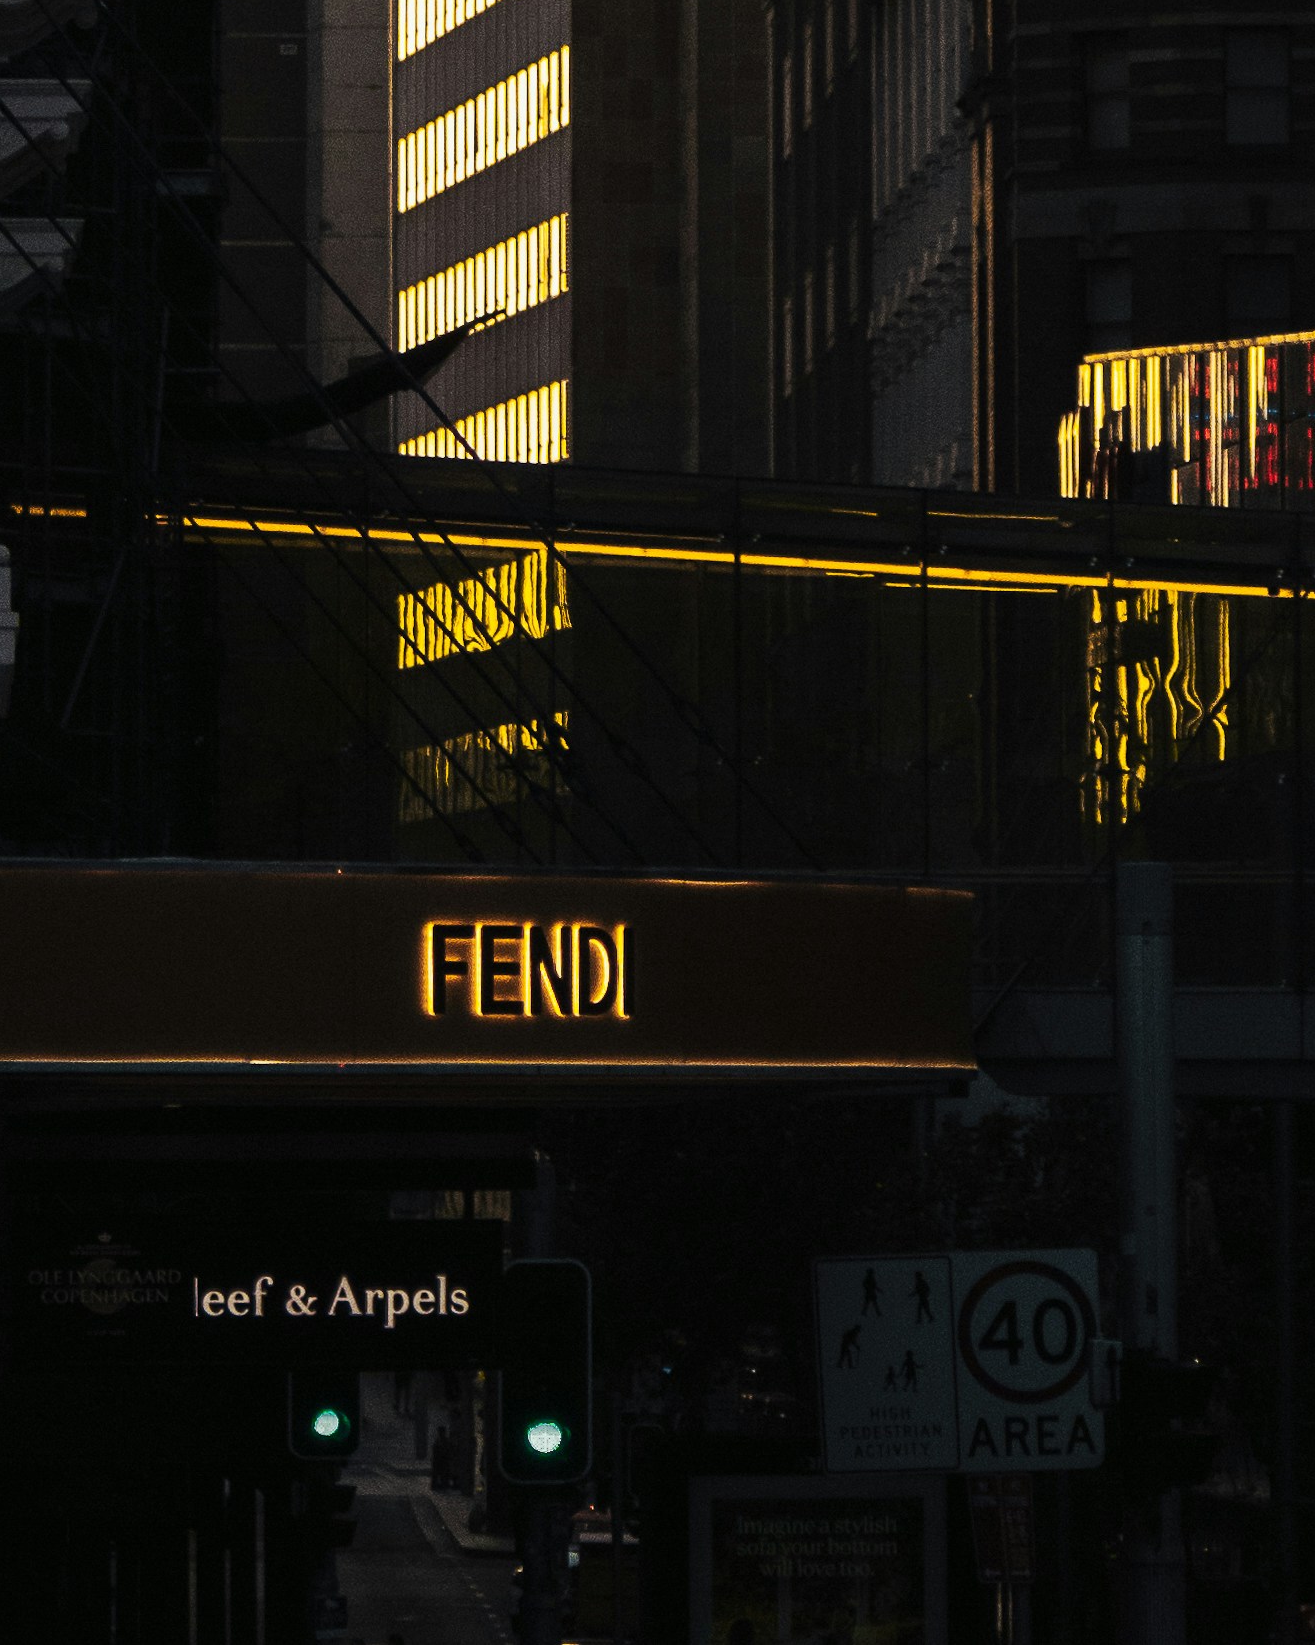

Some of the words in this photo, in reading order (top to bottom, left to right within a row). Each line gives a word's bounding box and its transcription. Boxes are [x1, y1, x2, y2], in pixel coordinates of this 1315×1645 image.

[424, 921, 635, 1018] FENDI
[27, 1270, 64, 1285] OLE
[68, 1269, 182, 1285] LYNGGAARD
[40, 1288, 169, 1304] COPENHAGEN
[285, 1284, 318, 1316] &
[328, 1274, 471, 1329] Arpels
[978, 1298, 1077, 1365] 40
[869, 1406, 911, 1421] HIGH
[840, 1424, 943, 1440] PEDESTRIAN
[967, 1414, 1097, 1458] AREA
[853, 1442, 930, 1459] ACTIVITY
[736, 1515, 816, 1538] Imagine
[818, 1520, 830, 1534] a
[834, 1515, 898, 1538] stylish
[736, 1537, 777, 1556] sofa
[779, 1543, 825, 1560] your
[827, 1538, 898, 1556] bottom
[759, 1556, 794, 1578] will
[797, 1558, 836, 1578] love
